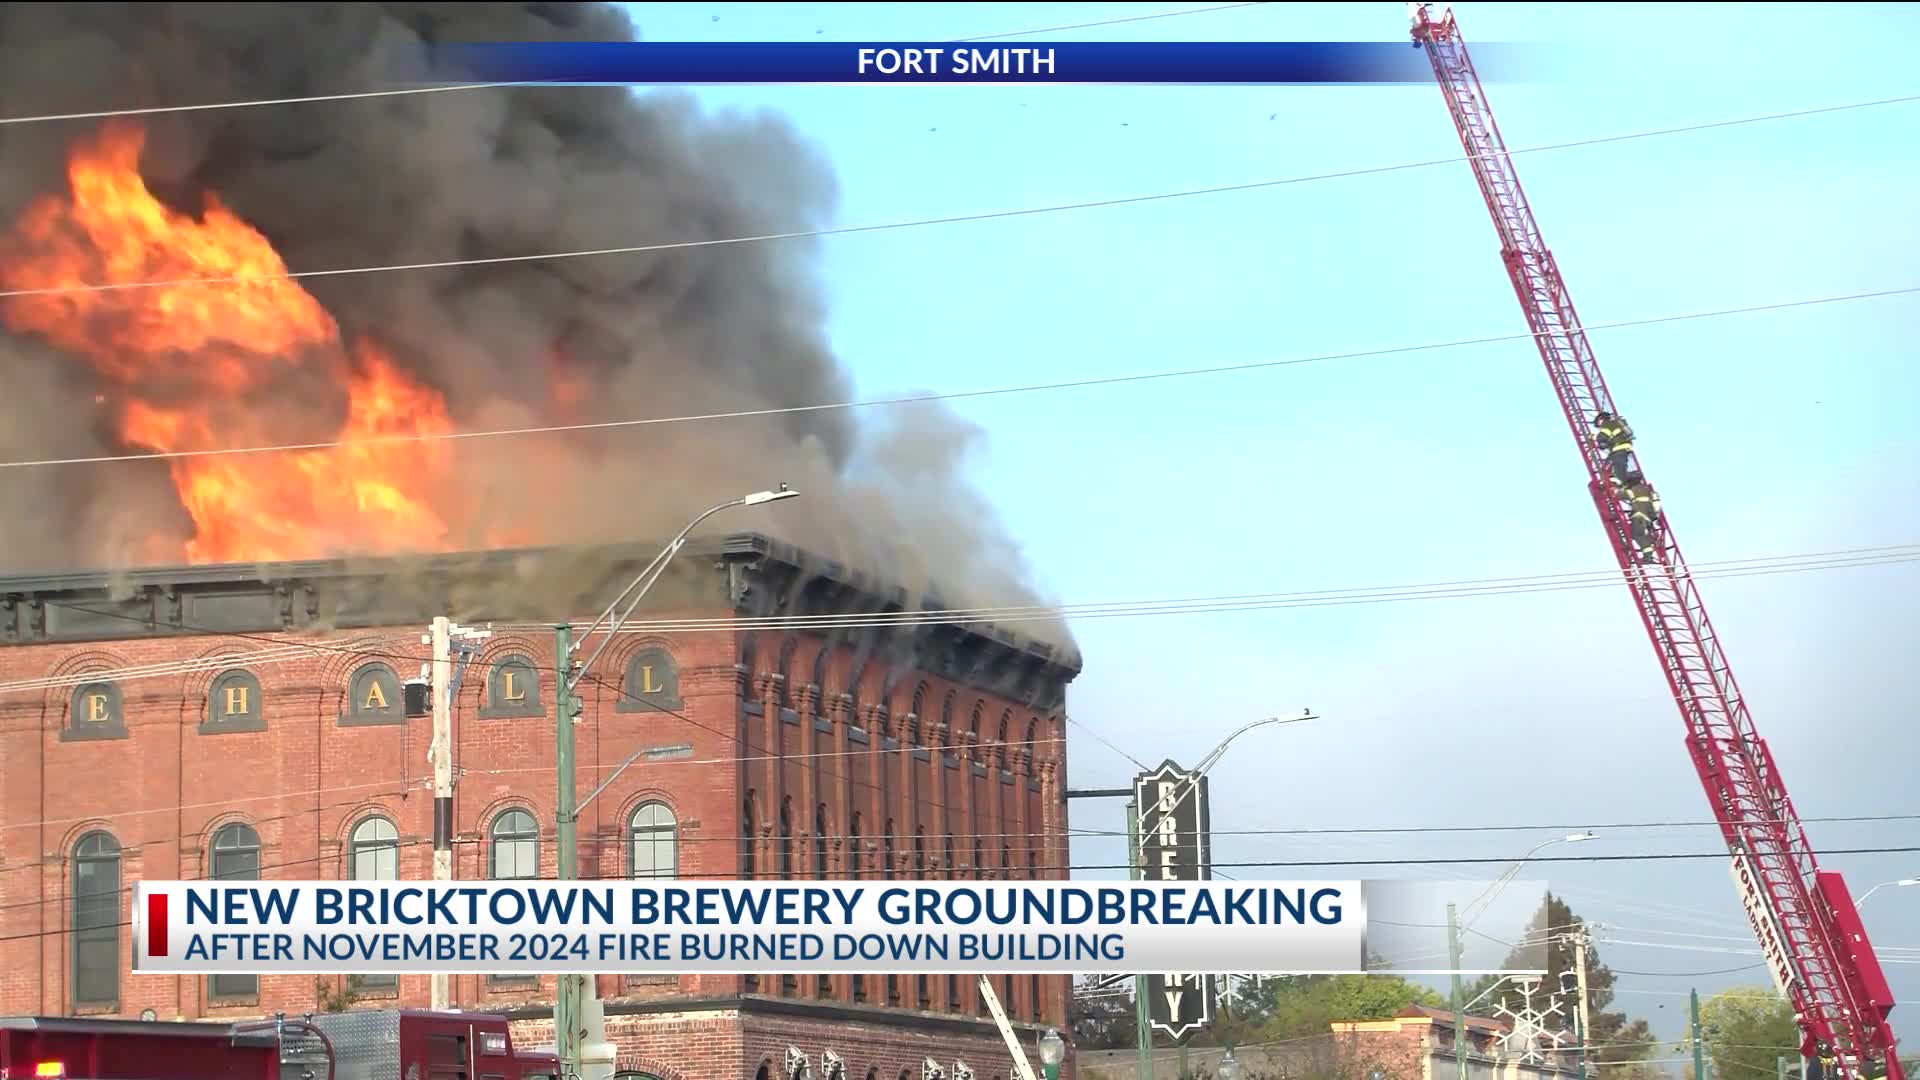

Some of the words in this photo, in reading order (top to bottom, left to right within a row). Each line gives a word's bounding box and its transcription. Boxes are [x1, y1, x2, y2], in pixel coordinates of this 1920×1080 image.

[1733, 856, 1761, 910] FORT
[1760, 915, 1790, 986] SMITH
[1743, 895, 1767, 951] LADDER
